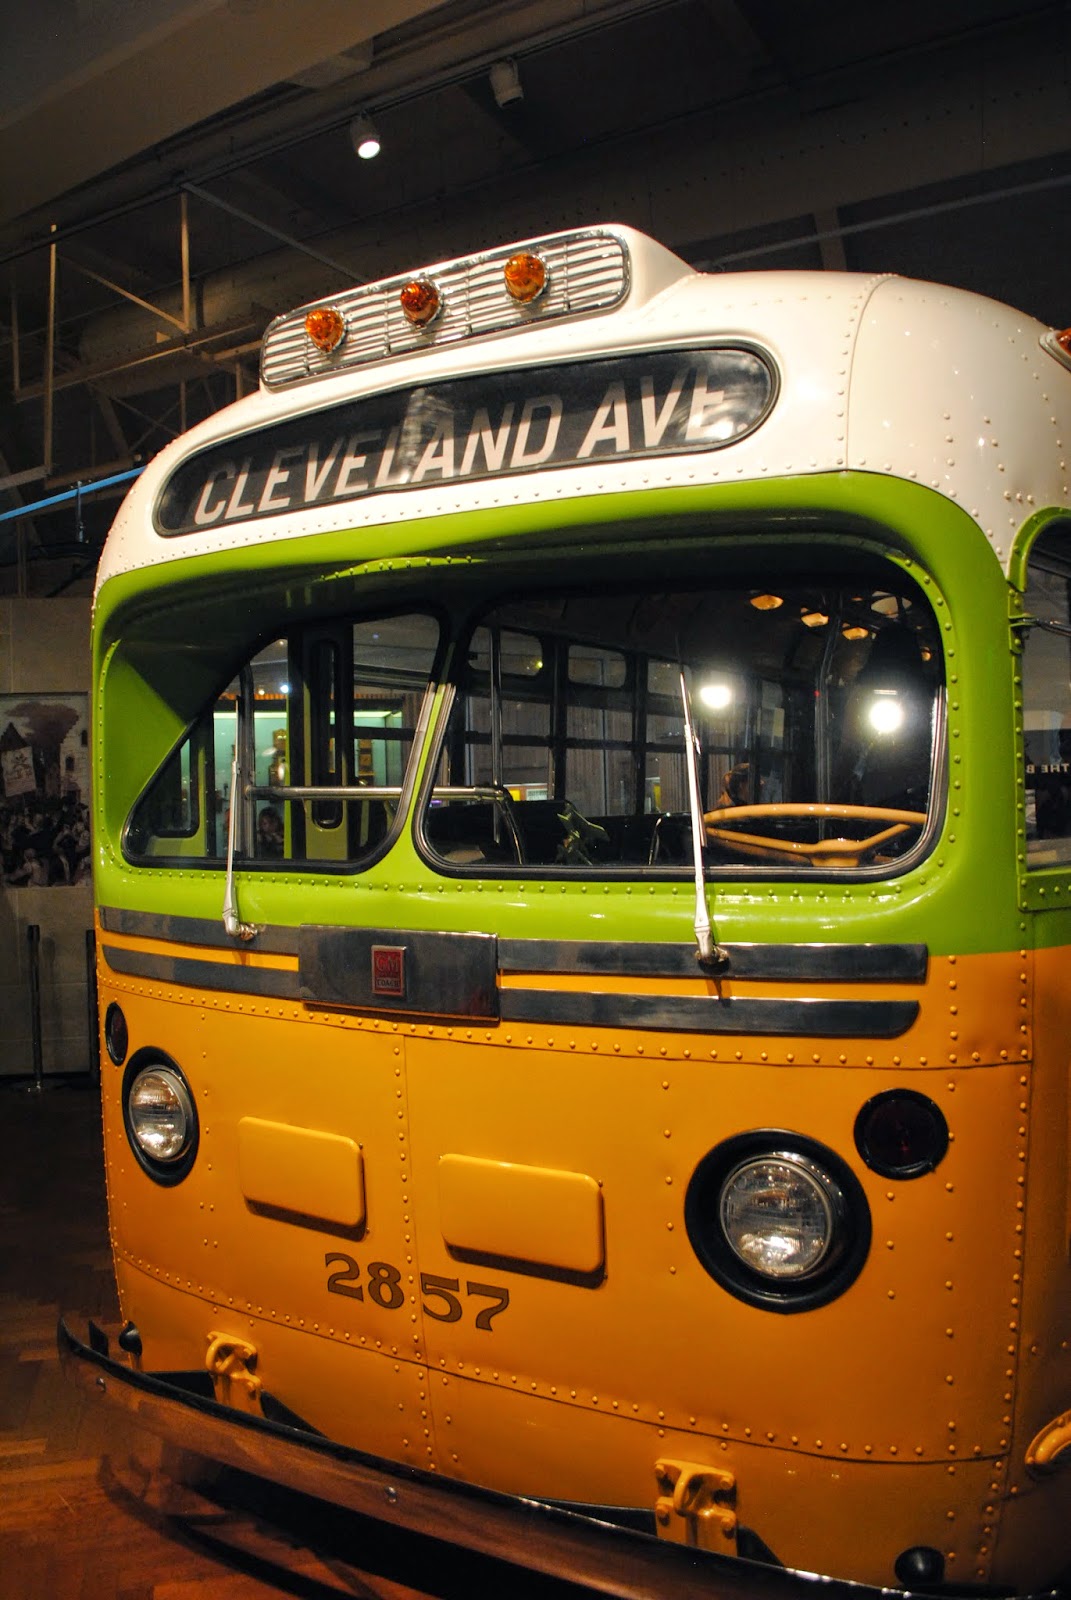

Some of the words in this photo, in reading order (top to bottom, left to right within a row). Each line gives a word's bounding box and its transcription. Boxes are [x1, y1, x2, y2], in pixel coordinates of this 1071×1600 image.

[194, 393, 564, 525] CLEVELAND
[576, 364, 728, 459] AVE
[325, 1252, 510, 1332] 2857
